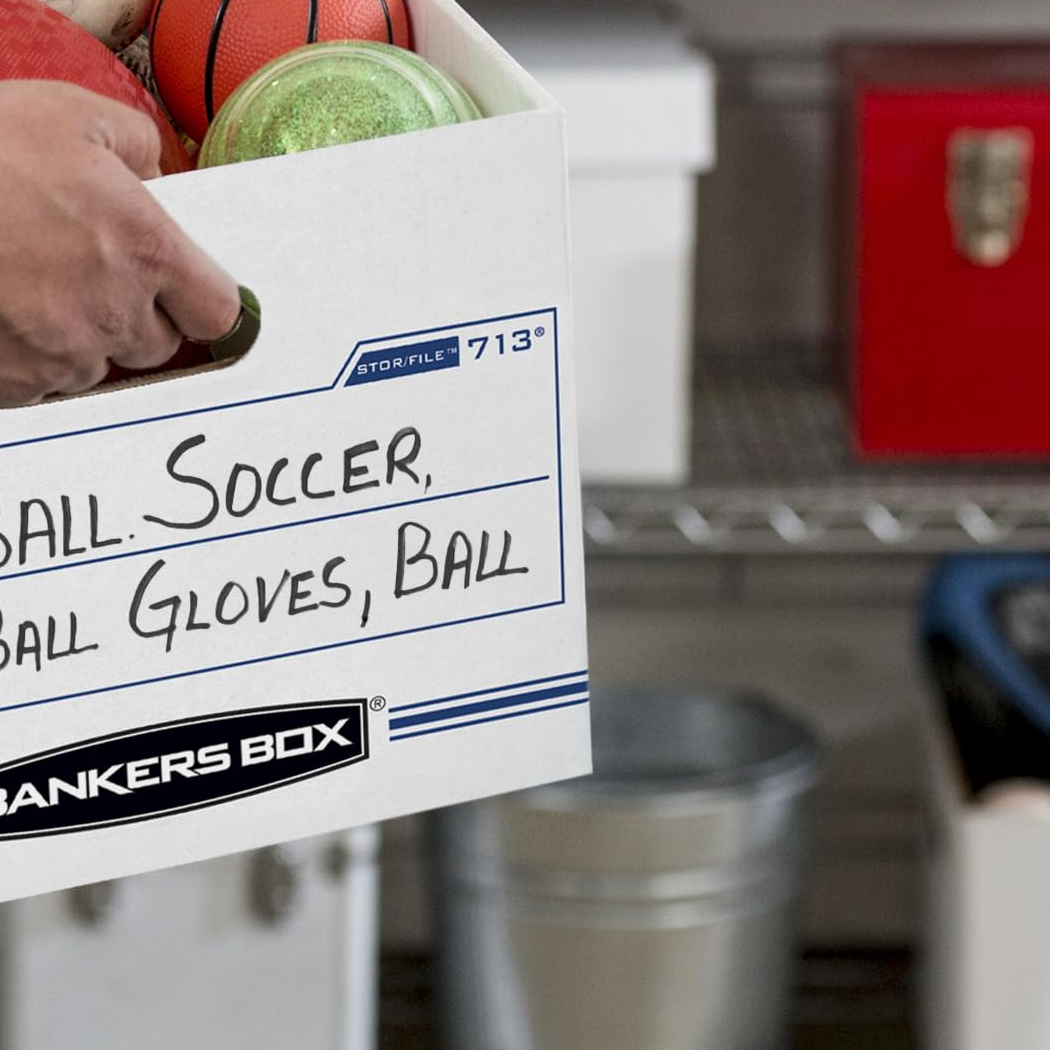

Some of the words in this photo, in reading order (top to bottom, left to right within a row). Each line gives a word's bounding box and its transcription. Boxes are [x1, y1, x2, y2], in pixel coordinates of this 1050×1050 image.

[142, 426, 432, 530] SOCCER,
[128, 556, 371, 653] GLOVES,
[393, 521, 530, 599] BALL
